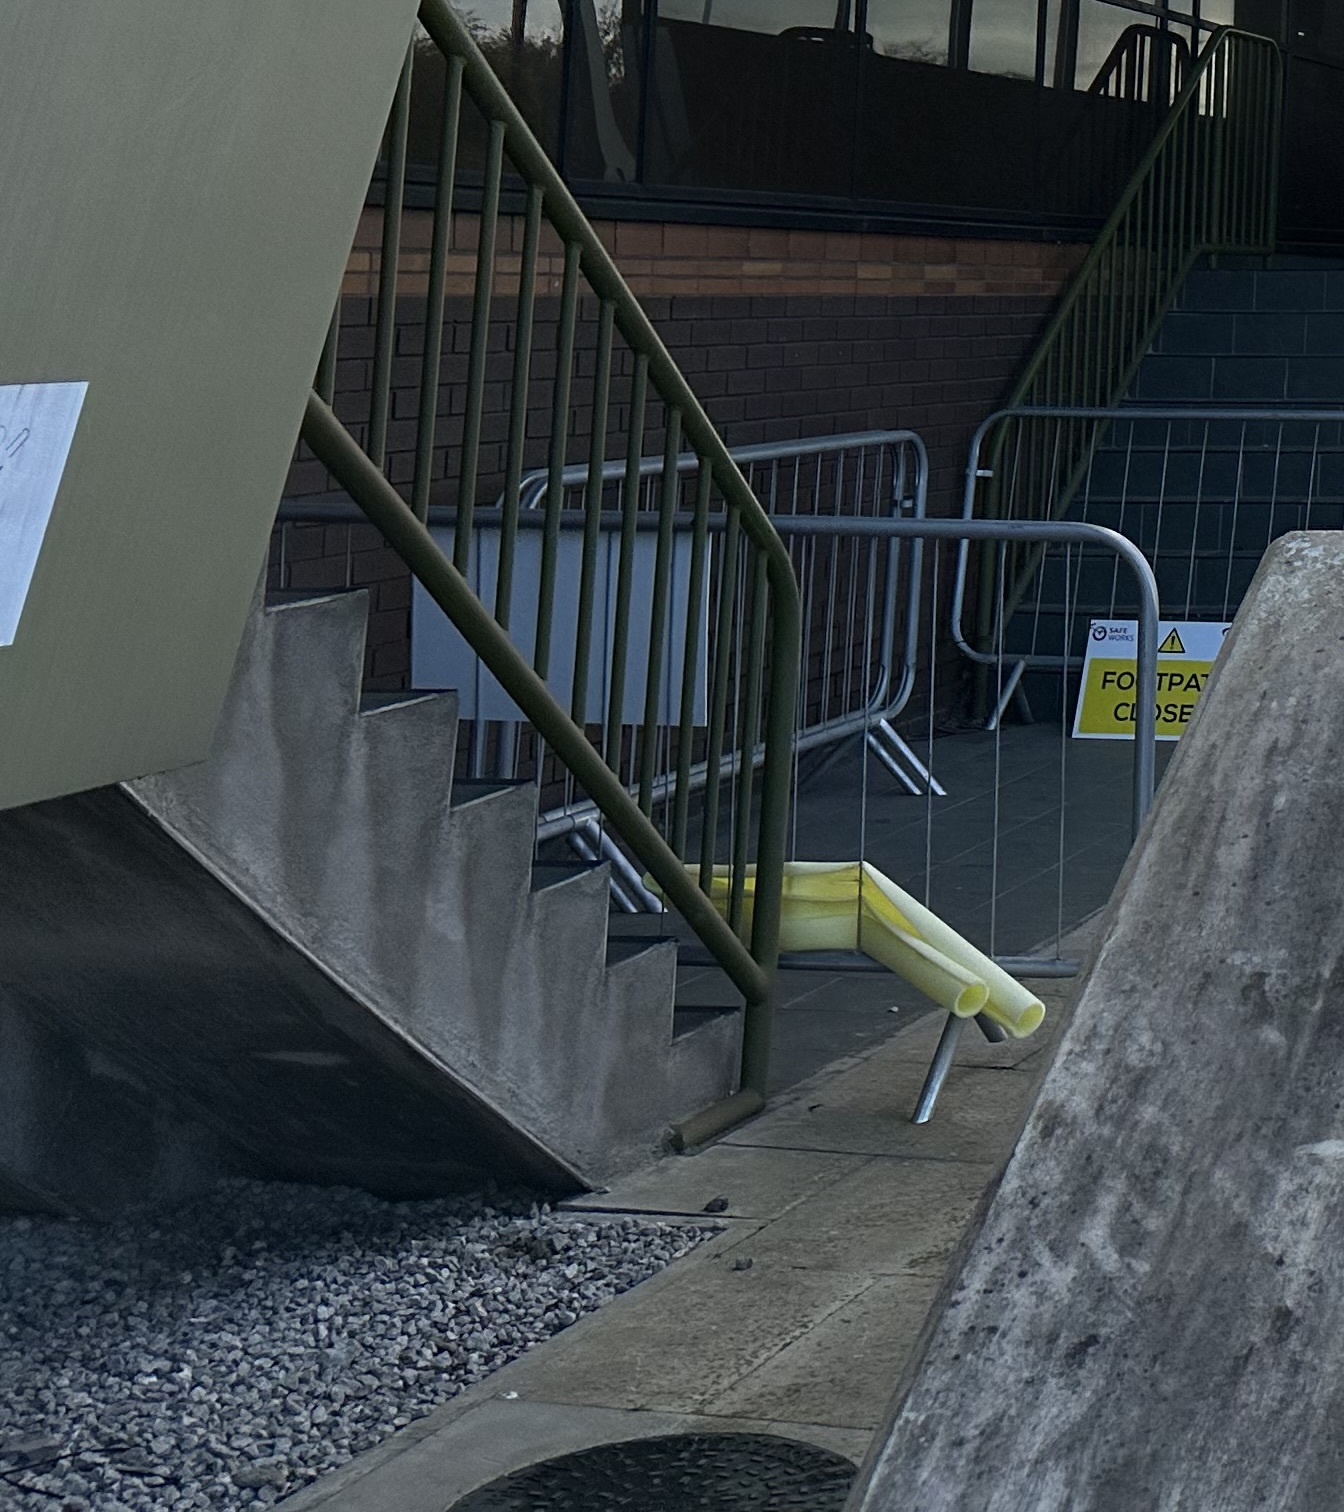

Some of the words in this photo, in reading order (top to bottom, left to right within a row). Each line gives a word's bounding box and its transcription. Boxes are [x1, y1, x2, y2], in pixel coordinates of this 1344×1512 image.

[1109, 627, 1128, 635] SAFE
[1108, 634, 1135, 642] WORKS
[1114, 702, 1194, 723] CLSE
